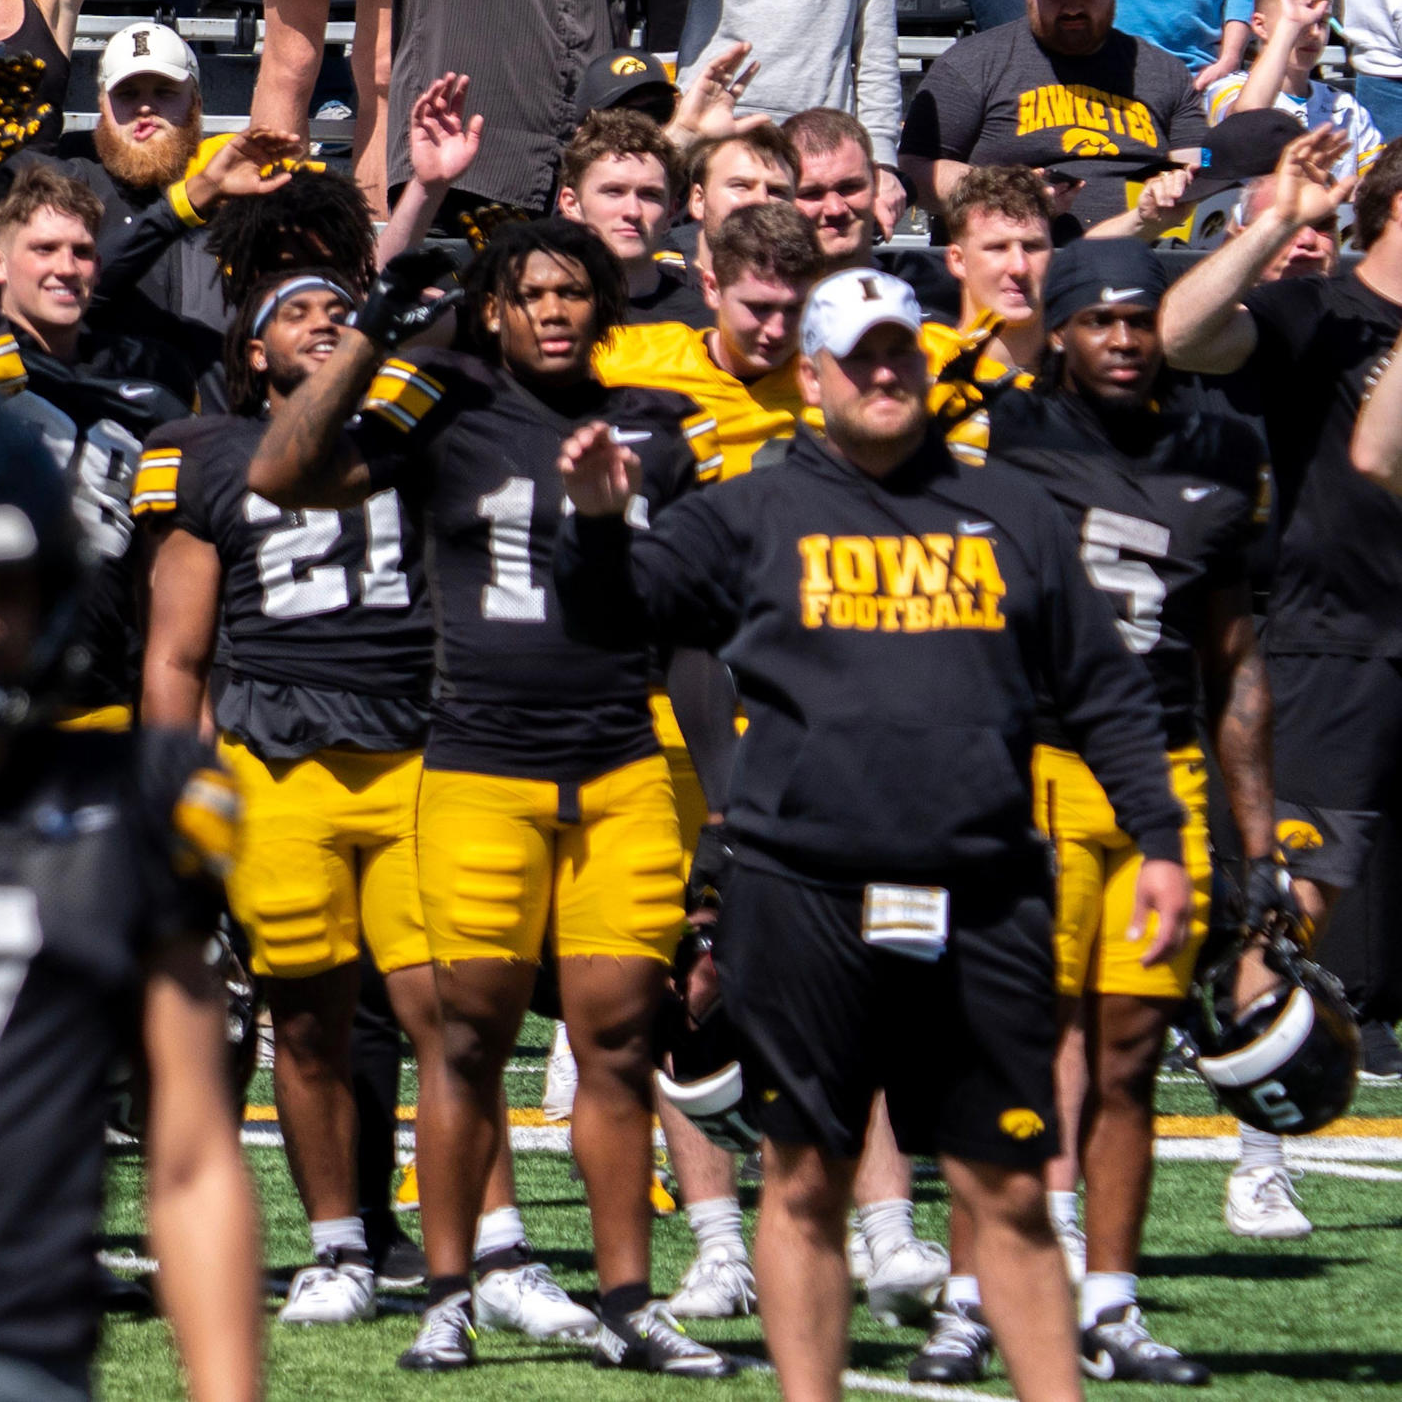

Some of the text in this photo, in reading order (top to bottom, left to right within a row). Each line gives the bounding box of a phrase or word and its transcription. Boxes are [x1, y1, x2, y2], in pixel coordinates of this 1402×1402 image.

[1016, 84, 1159, 148] HAWKEYES
[244, 487, 411, 620] 21
[797, 532, 1007, 597] IOWA
[1080, 506, 1172, 655] 5
[799, 591, 1006, 634] FOOTBALL
